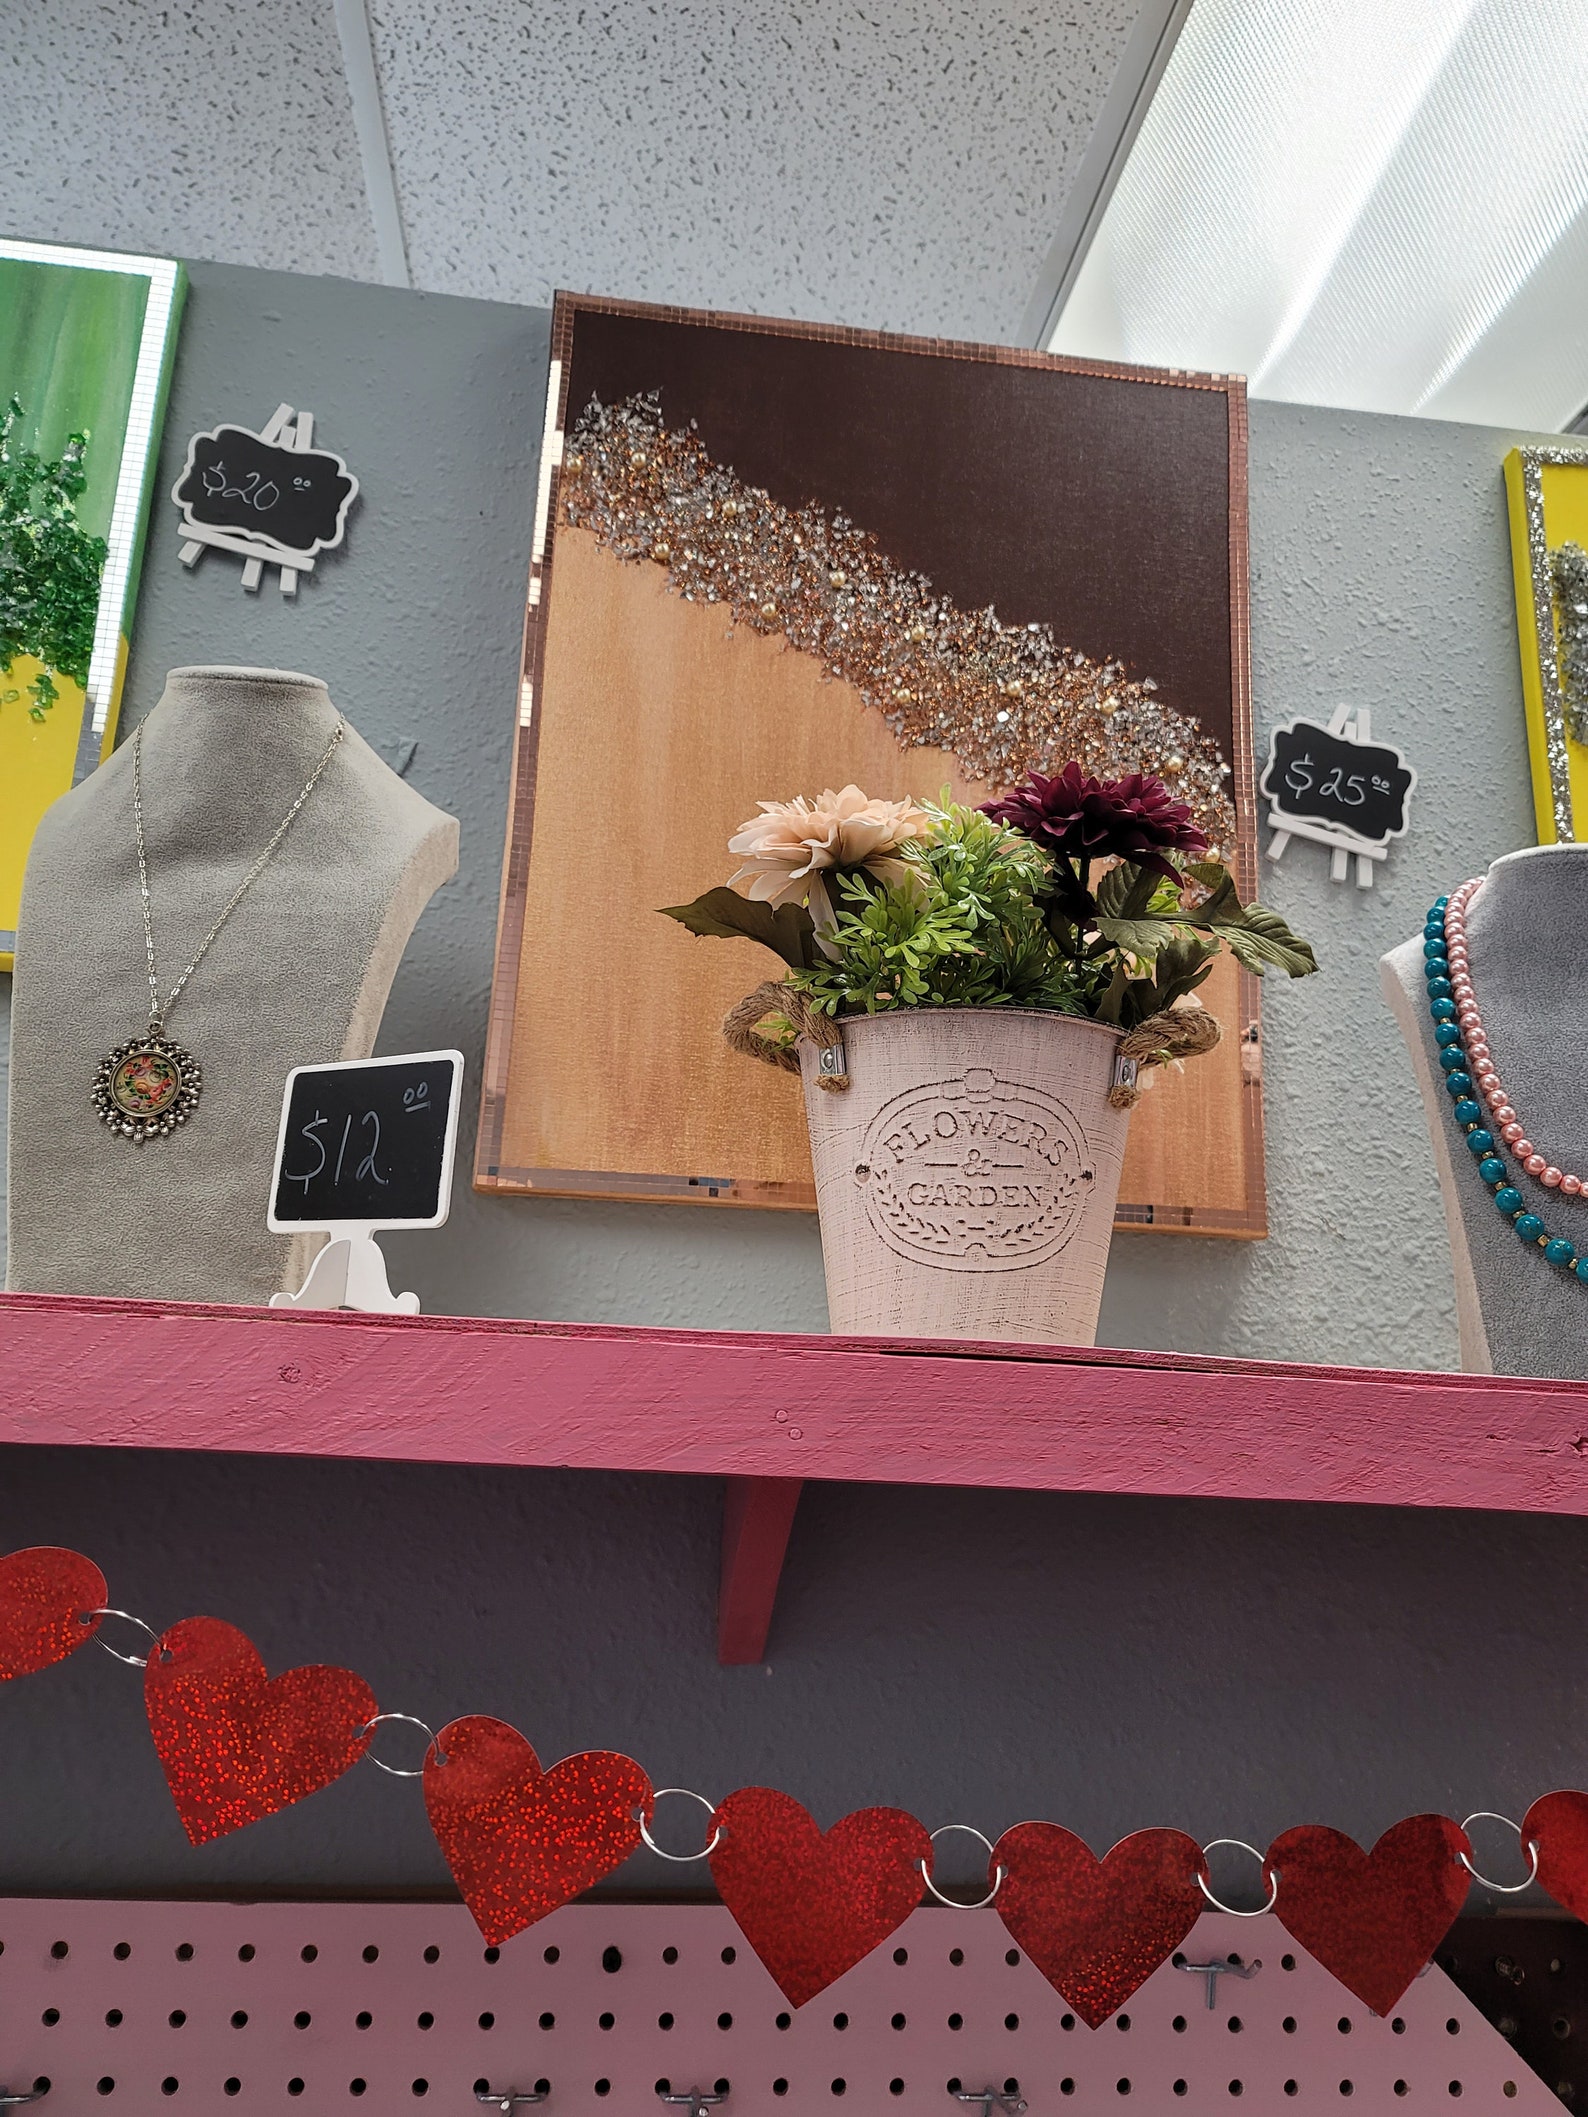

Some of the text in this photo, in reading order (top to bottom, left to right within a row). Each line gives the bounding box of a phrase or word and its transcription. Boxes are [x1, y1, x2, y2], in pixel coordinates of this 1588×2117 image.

[883, 1108, 1069, 1166] FLOWERS
[961, 1148, 993, 1177] &
[906, 1181, 1046, 1208] GARDEN
